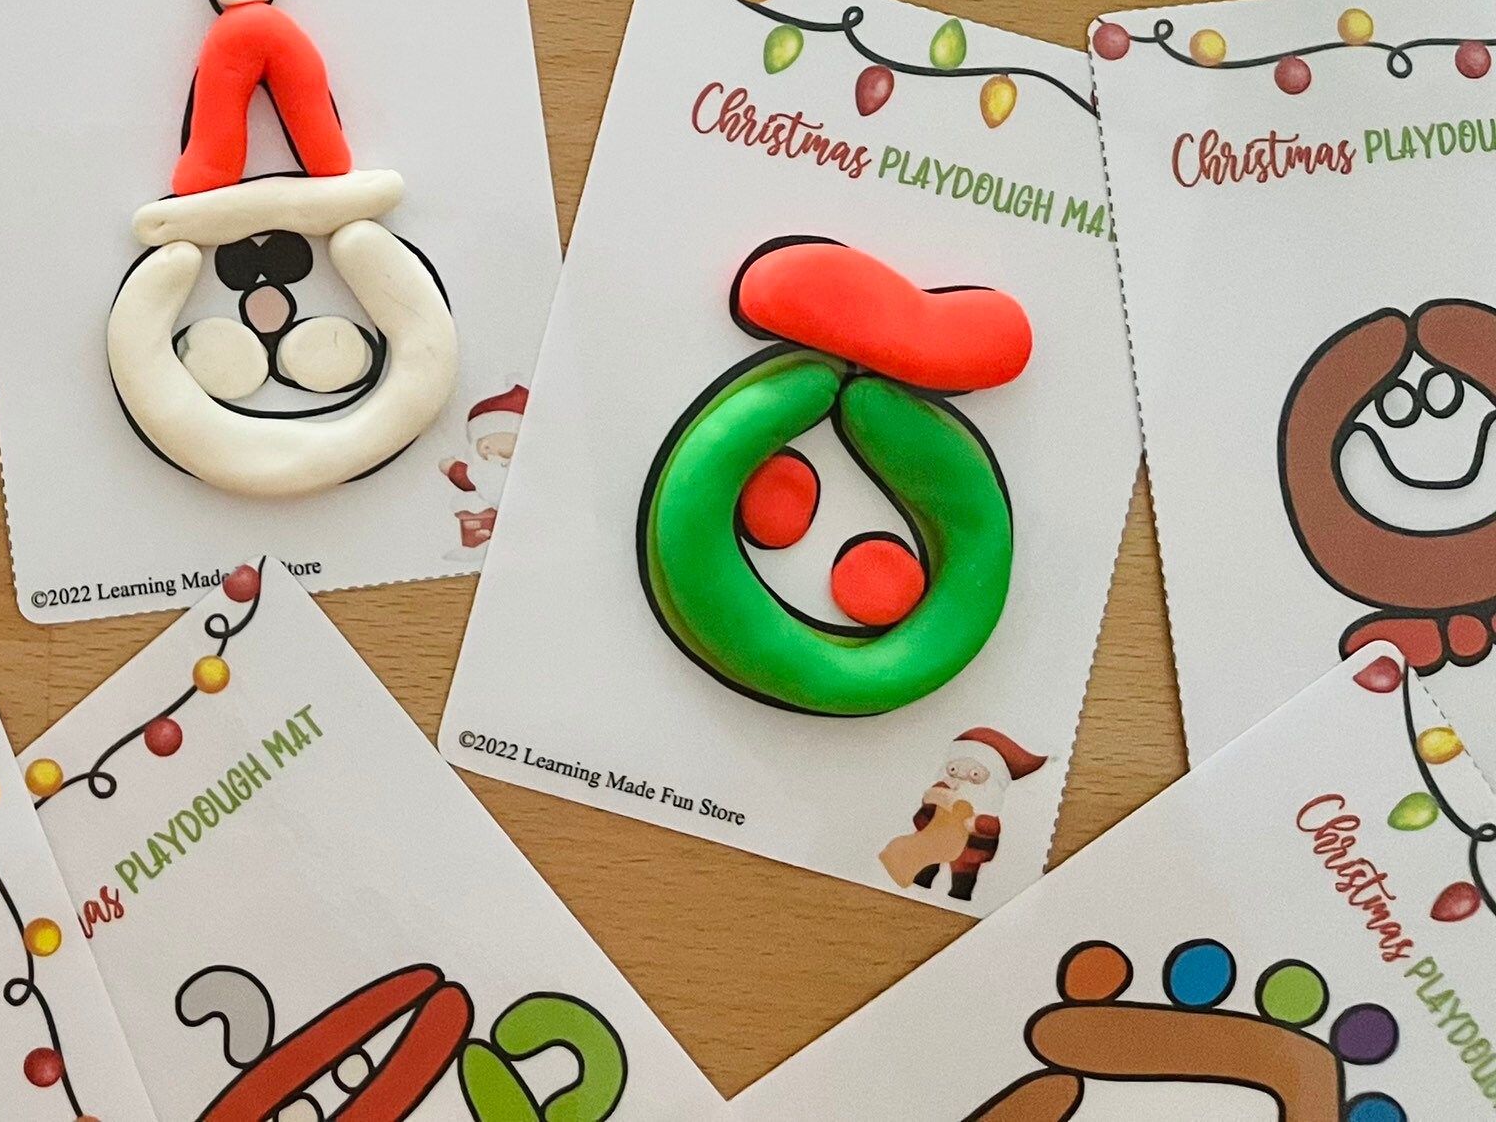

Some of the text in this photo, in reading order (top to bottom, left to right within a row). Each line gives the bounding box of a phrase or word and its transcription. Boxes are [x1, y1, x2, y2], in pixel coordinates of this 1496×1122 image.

[691, 81, 1117, 243] Christmas PLAYDOUGH MA
[1170, 129, 1357, 188] Christmas
[30, 585, 92, 609] ©2022
[96, 576, 178, 602] Learning
[280, 560, 322, 577] tore
[114, 752, 273, 895] PLAYDOUGH
[261, 703, 324, 769] MAT
[458, 730, 746, 826] ©2022 Learning Made Fun Store
[1295, 793, 1415, 963] Christmas
